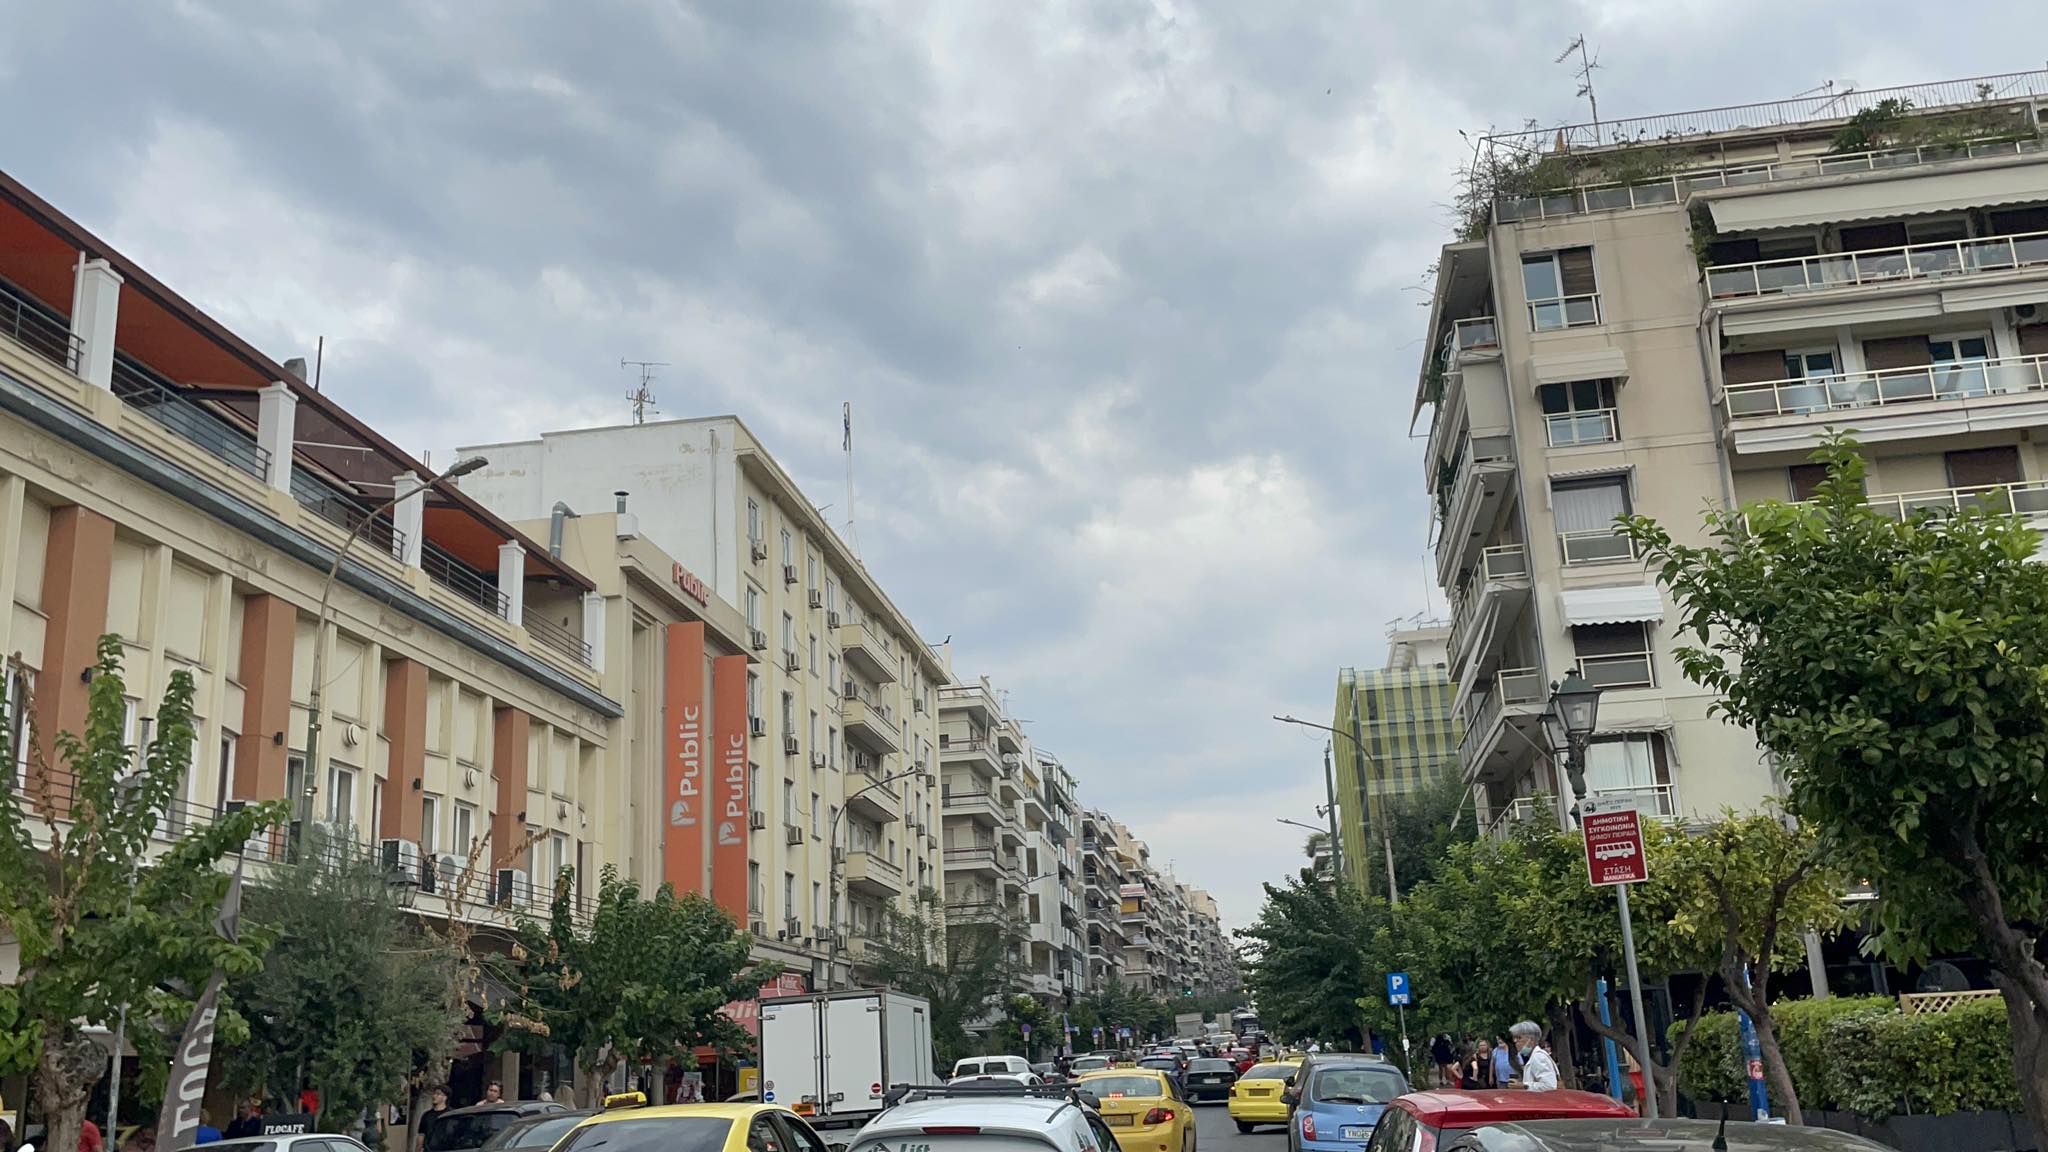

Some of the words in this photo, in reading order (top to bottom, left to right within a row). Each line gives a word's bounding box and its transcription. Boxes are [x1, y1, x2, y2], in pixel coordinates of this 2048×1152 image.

[680, 705, 698, 796] Public
[726, 733, 743, 817] Public
[1588, 822, 1636, 834] ΣΥΓΚΟΙΝΩΝΙΑ
[1592, 815, 1629, 826] ΔΗΜΟΤΙΚΗ
[1391, 975, 1403, 990] P
